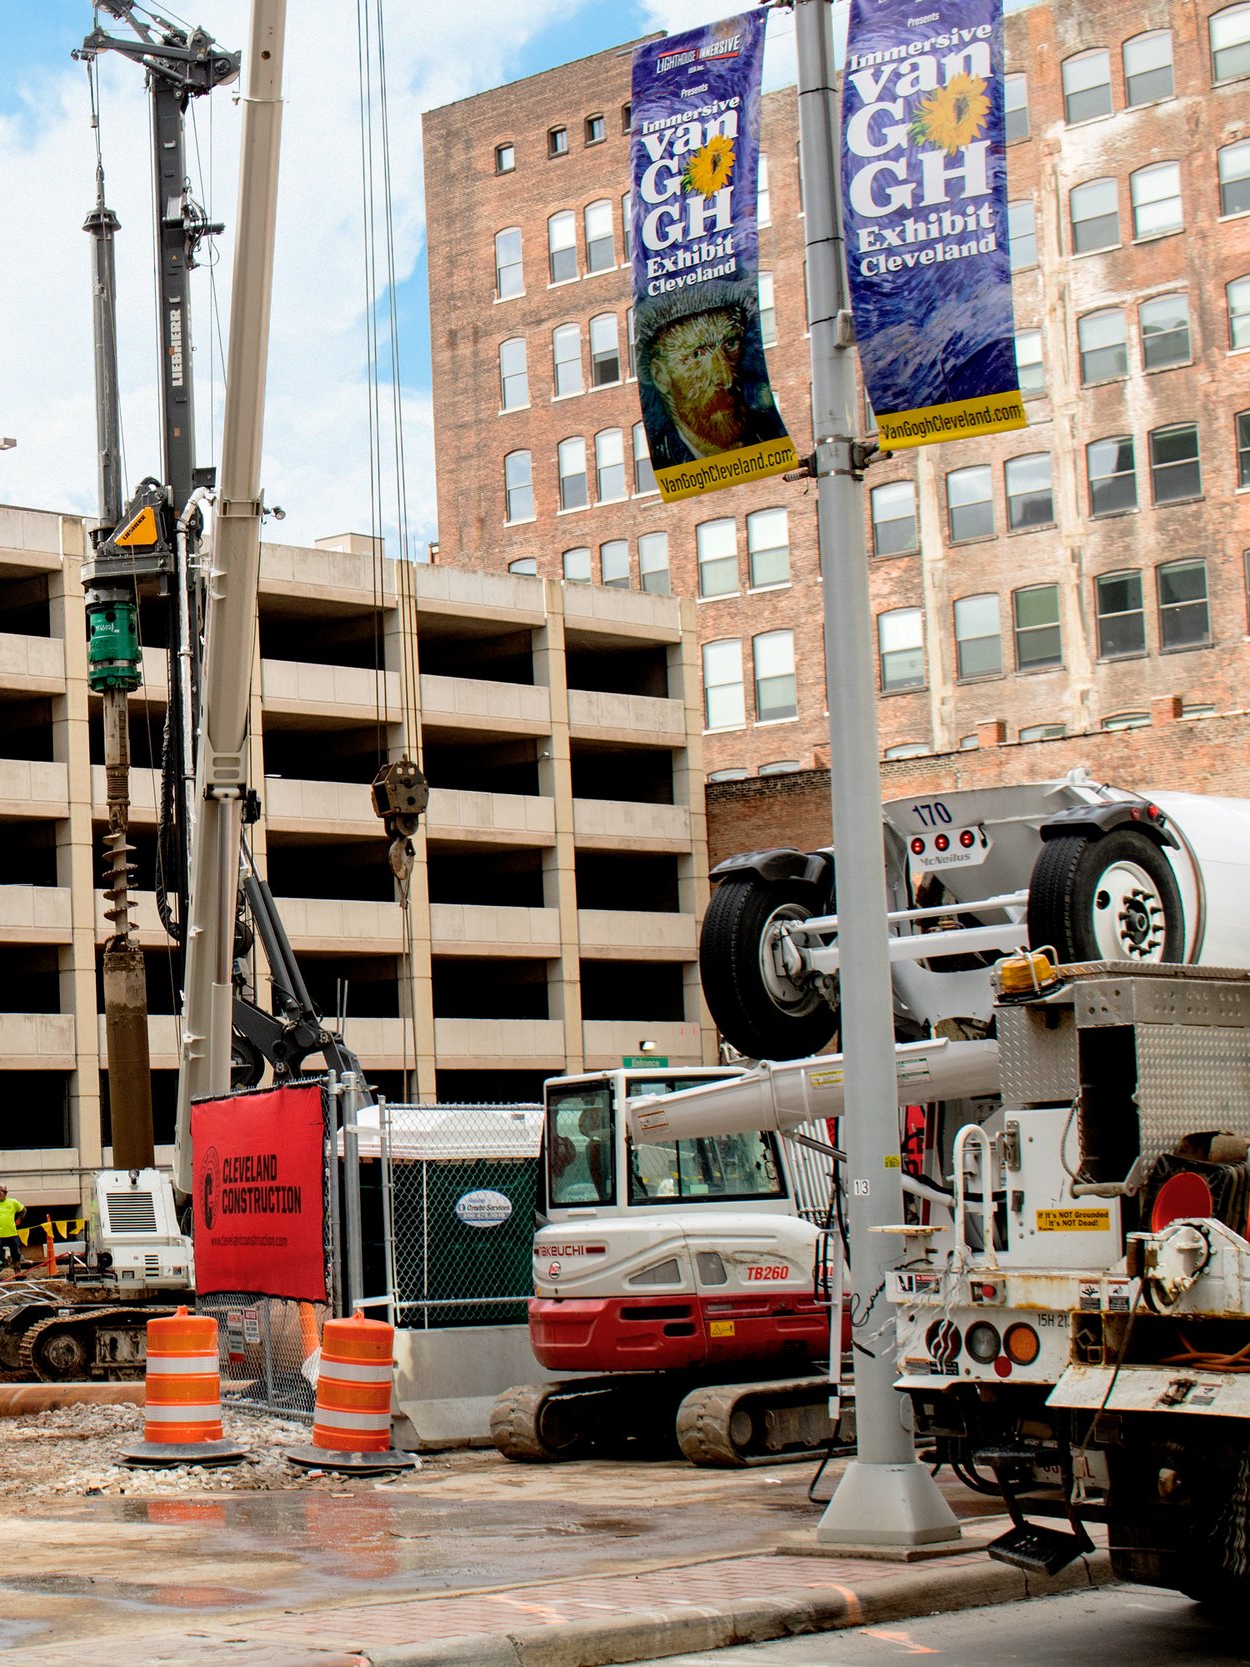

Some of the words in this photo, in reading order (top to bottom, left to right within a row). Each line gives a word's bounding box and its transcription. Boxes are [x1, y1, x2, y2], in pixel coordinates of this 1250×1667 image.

[907, 12, 940, 28] Presents
[656, 49, 697, 74] LIGHTHOUSE
[699, 35, 741, 59] IMMERSIVE
[851, 24, 992, 71] Immersive
[681, 83, 709, 98] Presents
[642, 96, 740, 134] Immersive
[850, 140, 992, 218] GH
[642, 185, 734, 251] GH
[857, 204, 995, 253] Exhibit
[646, 239, 735, 278] Exhibit
[860, 233, 998, 277] Cleveland
[647, 257, 737, 297] Cleveland
[168, 308, 183, 387] LIEBHERR
[881, 403, 1023, 441] VanGoghCleveland.com
[661, 448, 794, 494] VanGoghCleveland.com
[912, 802, 952, 826] 170
[920, 853, 971, 866] McNeilus
[222, 1154, 277, 1184] CLEVELAND
[855, 1180, 869, 1195] 13
[222, 1186, 302, 1214] CONSTRUCTION
[1058, 1211, 1072, 1219] NOT
[1075, 1211, 1109, 1219] Grounded
[1078, 1219, 1098, 1227] Dead!
[747, 1265, 789, 1280] TB260
[1037, 1313, 1054, 1327] 15H
